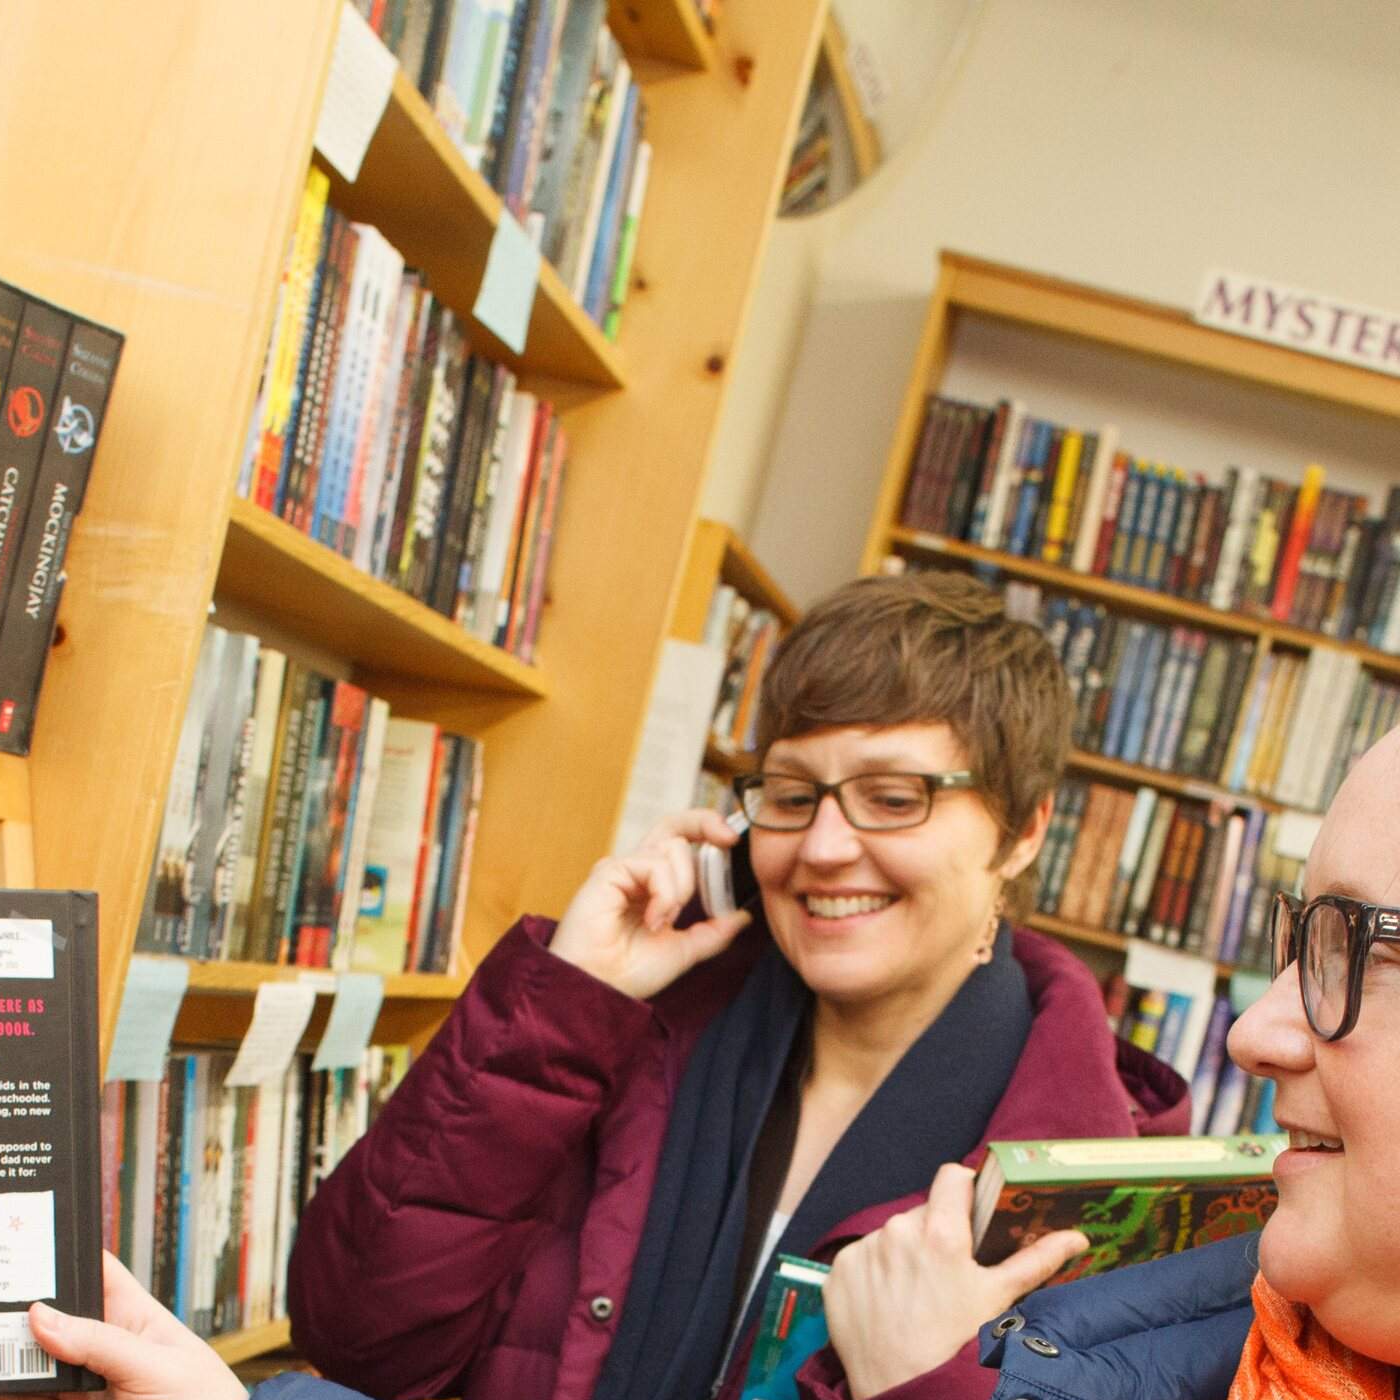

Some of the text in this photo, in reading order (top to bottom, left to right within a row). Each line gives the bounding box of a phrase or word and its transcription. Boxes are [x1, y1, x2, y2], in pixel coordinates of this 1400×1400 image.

[23, 481, 69, 621] MOCKINGJAY
[28, 998, 45, 1013] AS
[19, 1080, 30, 1091] in
[33, 1080, 51, 1091] the
